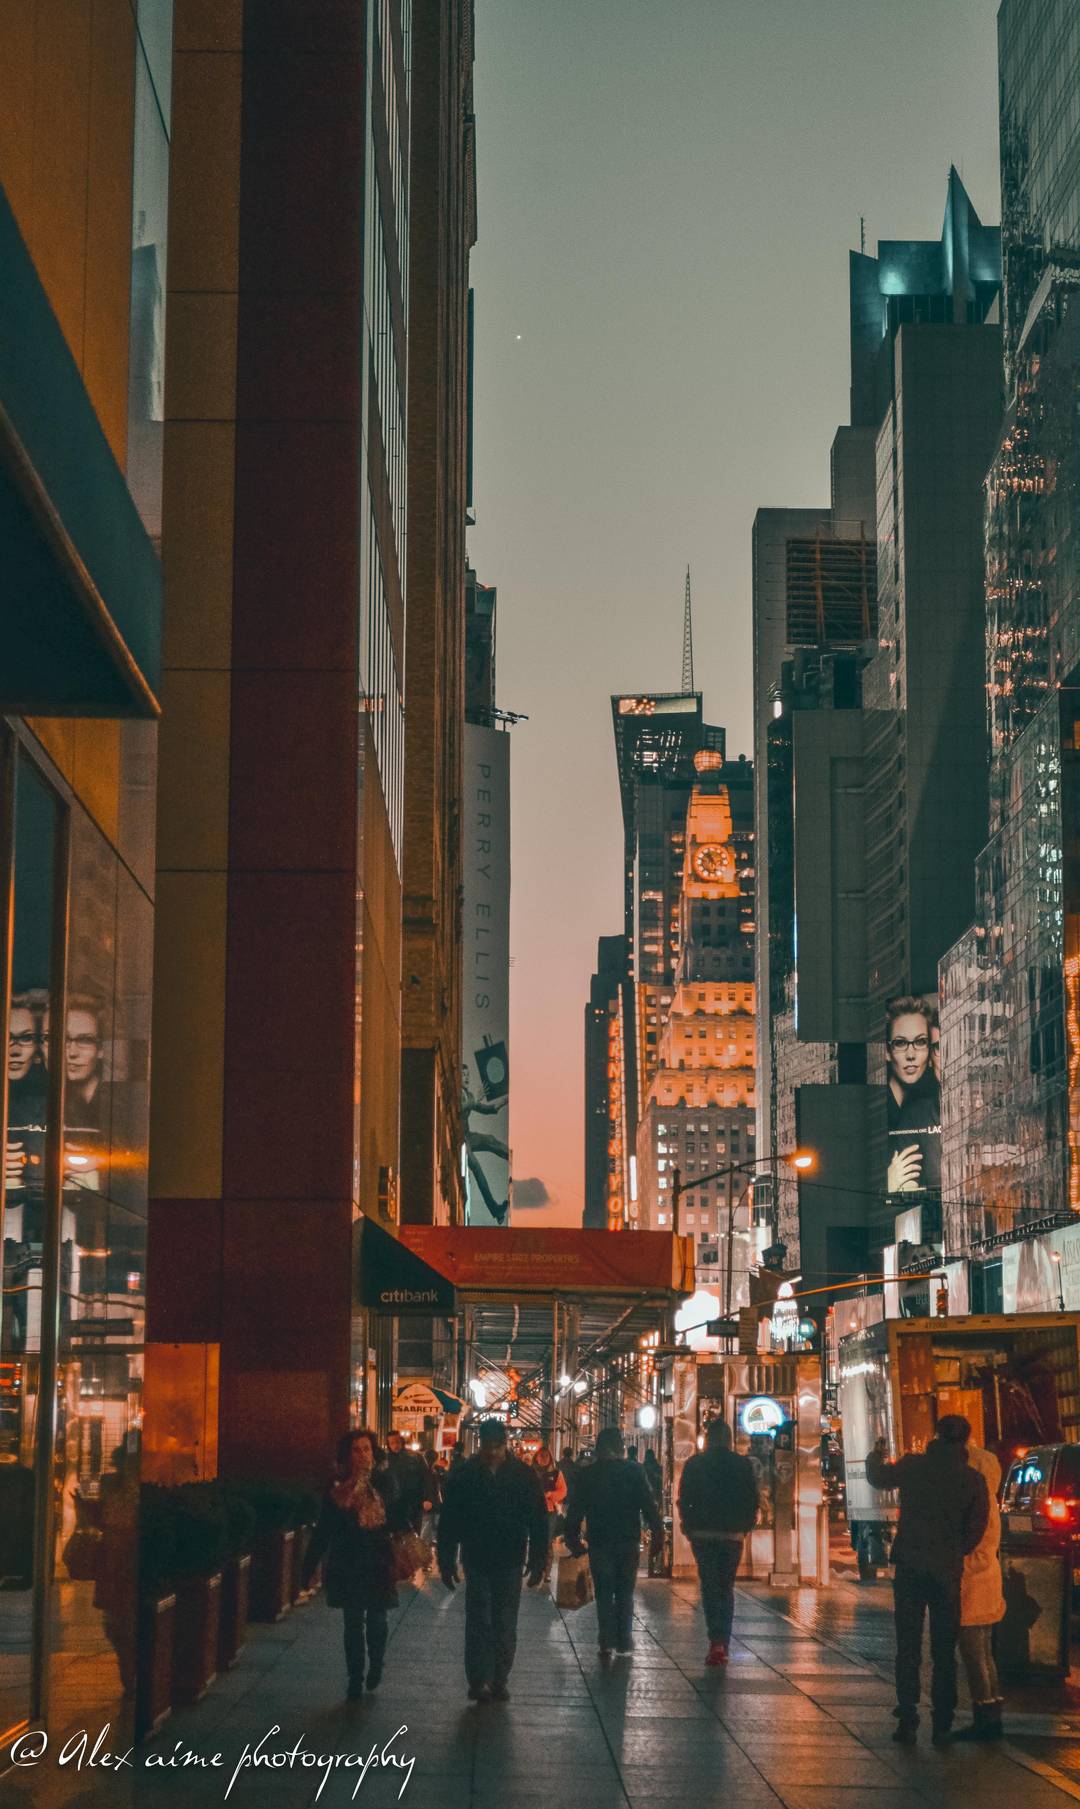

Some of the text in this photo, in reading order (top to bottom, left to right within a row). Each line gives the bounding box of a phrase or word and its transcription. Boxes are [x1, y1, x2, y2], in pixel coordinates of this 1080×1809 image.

[475, 763, 491, 1009] PERRY ELLIS
[608, 1019, 622, 1120] ERNST
[381, 1289, 439, 1302] citibank
